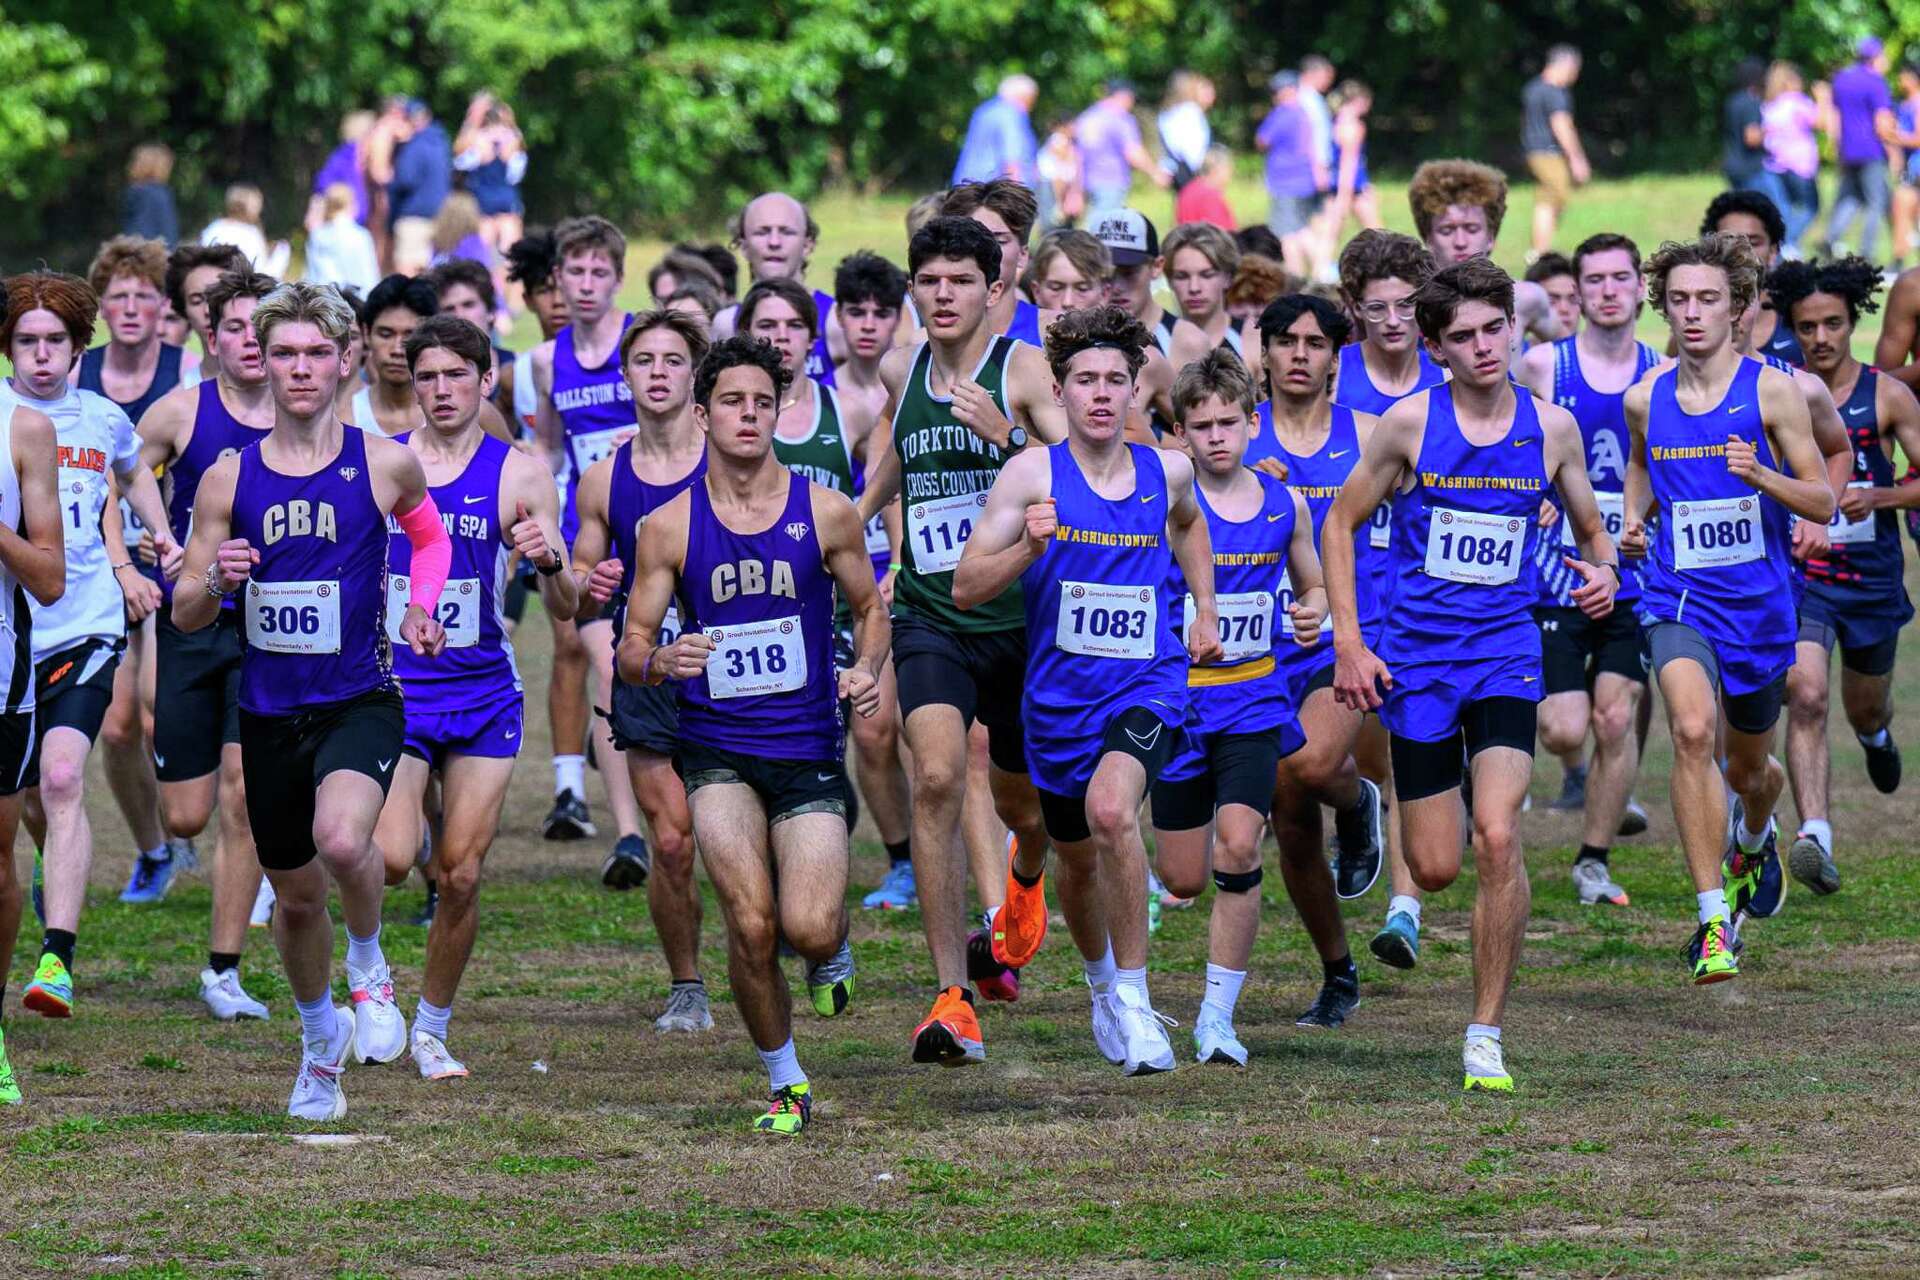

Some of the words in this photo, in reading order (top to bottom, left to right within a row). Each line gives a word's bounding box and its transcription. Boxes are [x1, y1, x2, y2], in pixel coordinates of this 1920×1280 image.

[901, 425, 1000, 464] YORKTOWN
[1651, 441, 1758, 461] WASHINGTONE
[906, 471, 940, 498] CROSS
[1421, 472, 1541, 490] WASHINGTONVILLE
[262, 499, 337, 546] CBA
[459, 515, 488, 540] SPA
[1682, 518, 1752, 549] 1080
[1439, 532, 1514, 567] 1084
[711, 559, 797, 604] CBA
[259, 605, 320, 635] 306
[1071, 606, 1147, 639] 1083
[725, 643, 787, 678] 318
